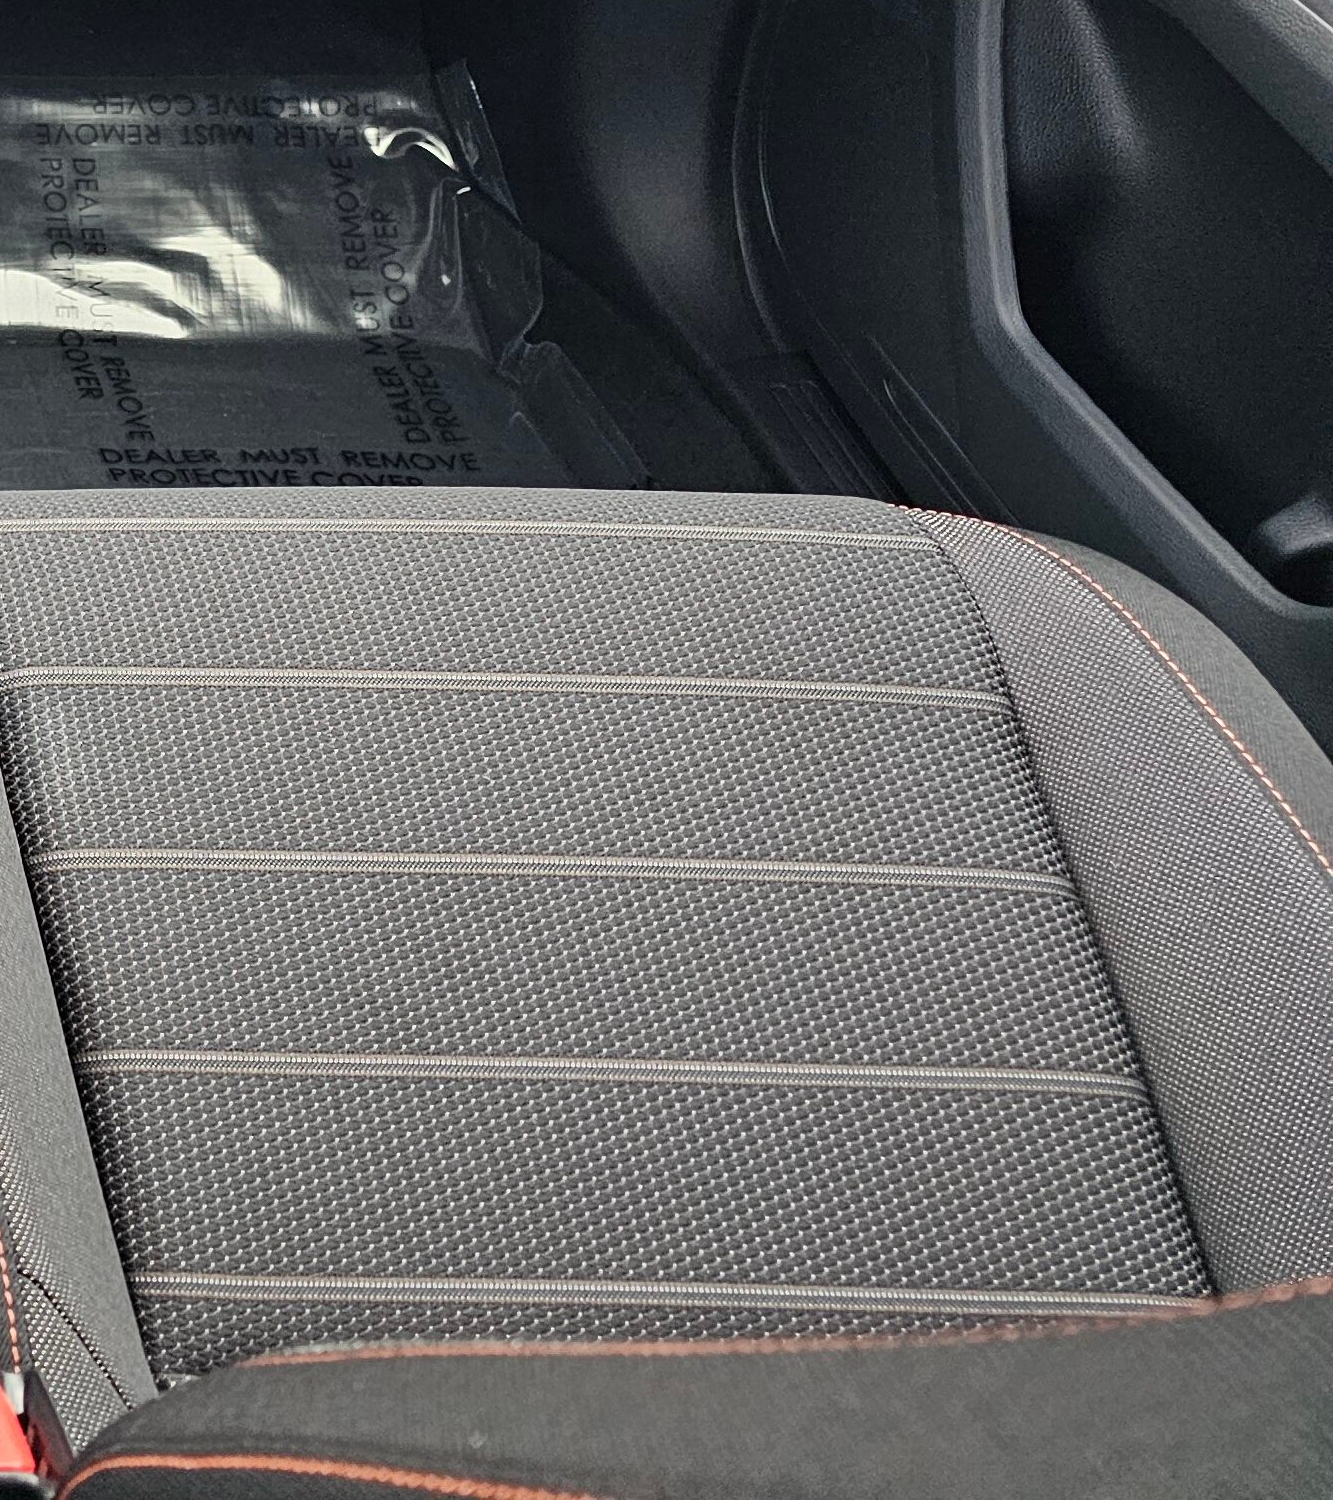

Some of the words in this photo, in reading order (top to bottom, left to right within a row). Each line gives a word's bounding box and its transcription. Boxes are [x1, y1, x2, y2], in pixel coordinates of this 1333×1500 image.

[35, 123, 162, 147] REMOVE
[72, 157, 107, 256] DEALER
[330, 155, 371, 272] REMOVE
[97, 447, 222, 466] DEALER
[237, 446, 322, 466] MUST
[338, 449, 483, 473] REMOVE
[107, 466, 302, 487] PROTECTIVE
